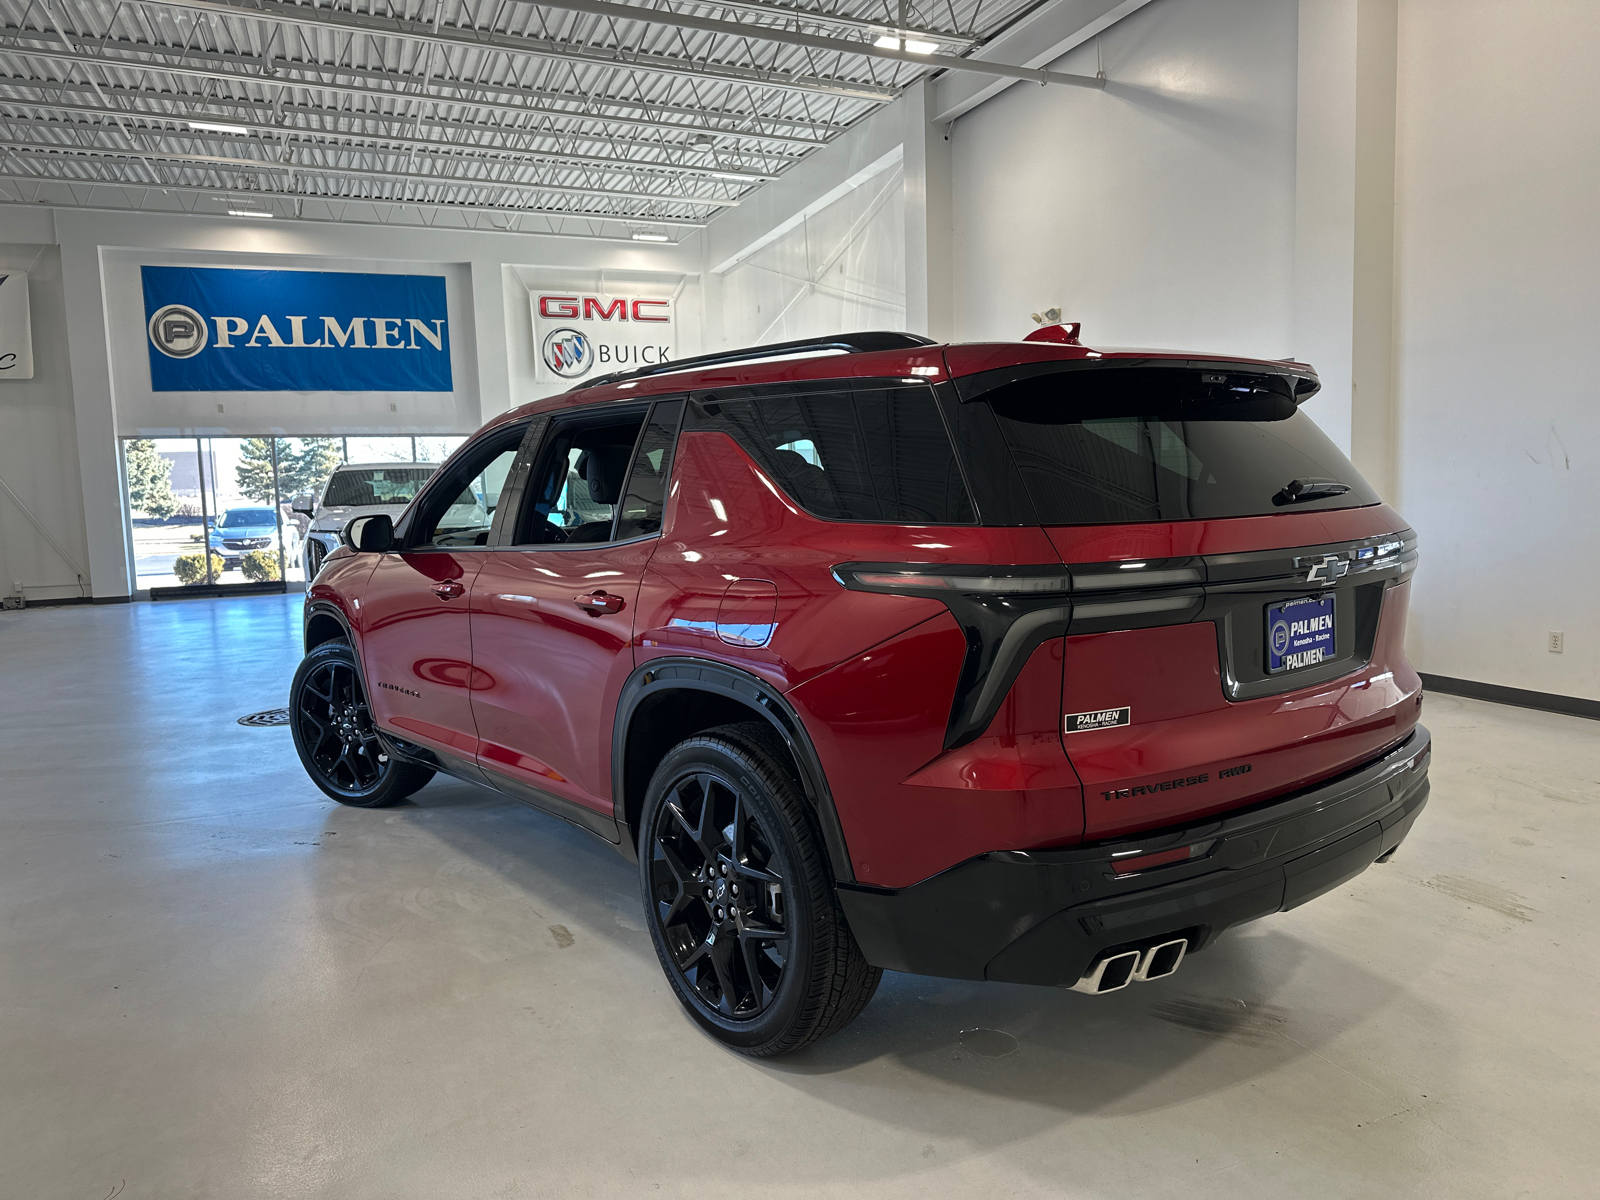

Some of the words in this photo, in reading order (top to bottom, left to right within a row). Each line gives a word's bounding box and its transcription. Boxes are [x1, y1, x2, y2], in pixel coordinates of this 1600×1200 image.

[537, 294, 671, 323] GMC
[210, 314, 446, 351] PALMEN
[599, 344, 670, 364] BUICK
[1291, 614, 1332, 637] PALMEN
[1294, 637, 1312, 647] Kenosha
[1316, 633, 1330, 642] Racine
[1286, 649, 1323, 670] PALMEN
[377, 681, 421, 699] TRAVERSE
[1077, 711, 1120, 724] PALMEN
[1101, 772, 1209, 801] TRAVERSE
[1218, 764, 1253, 780] AWD
